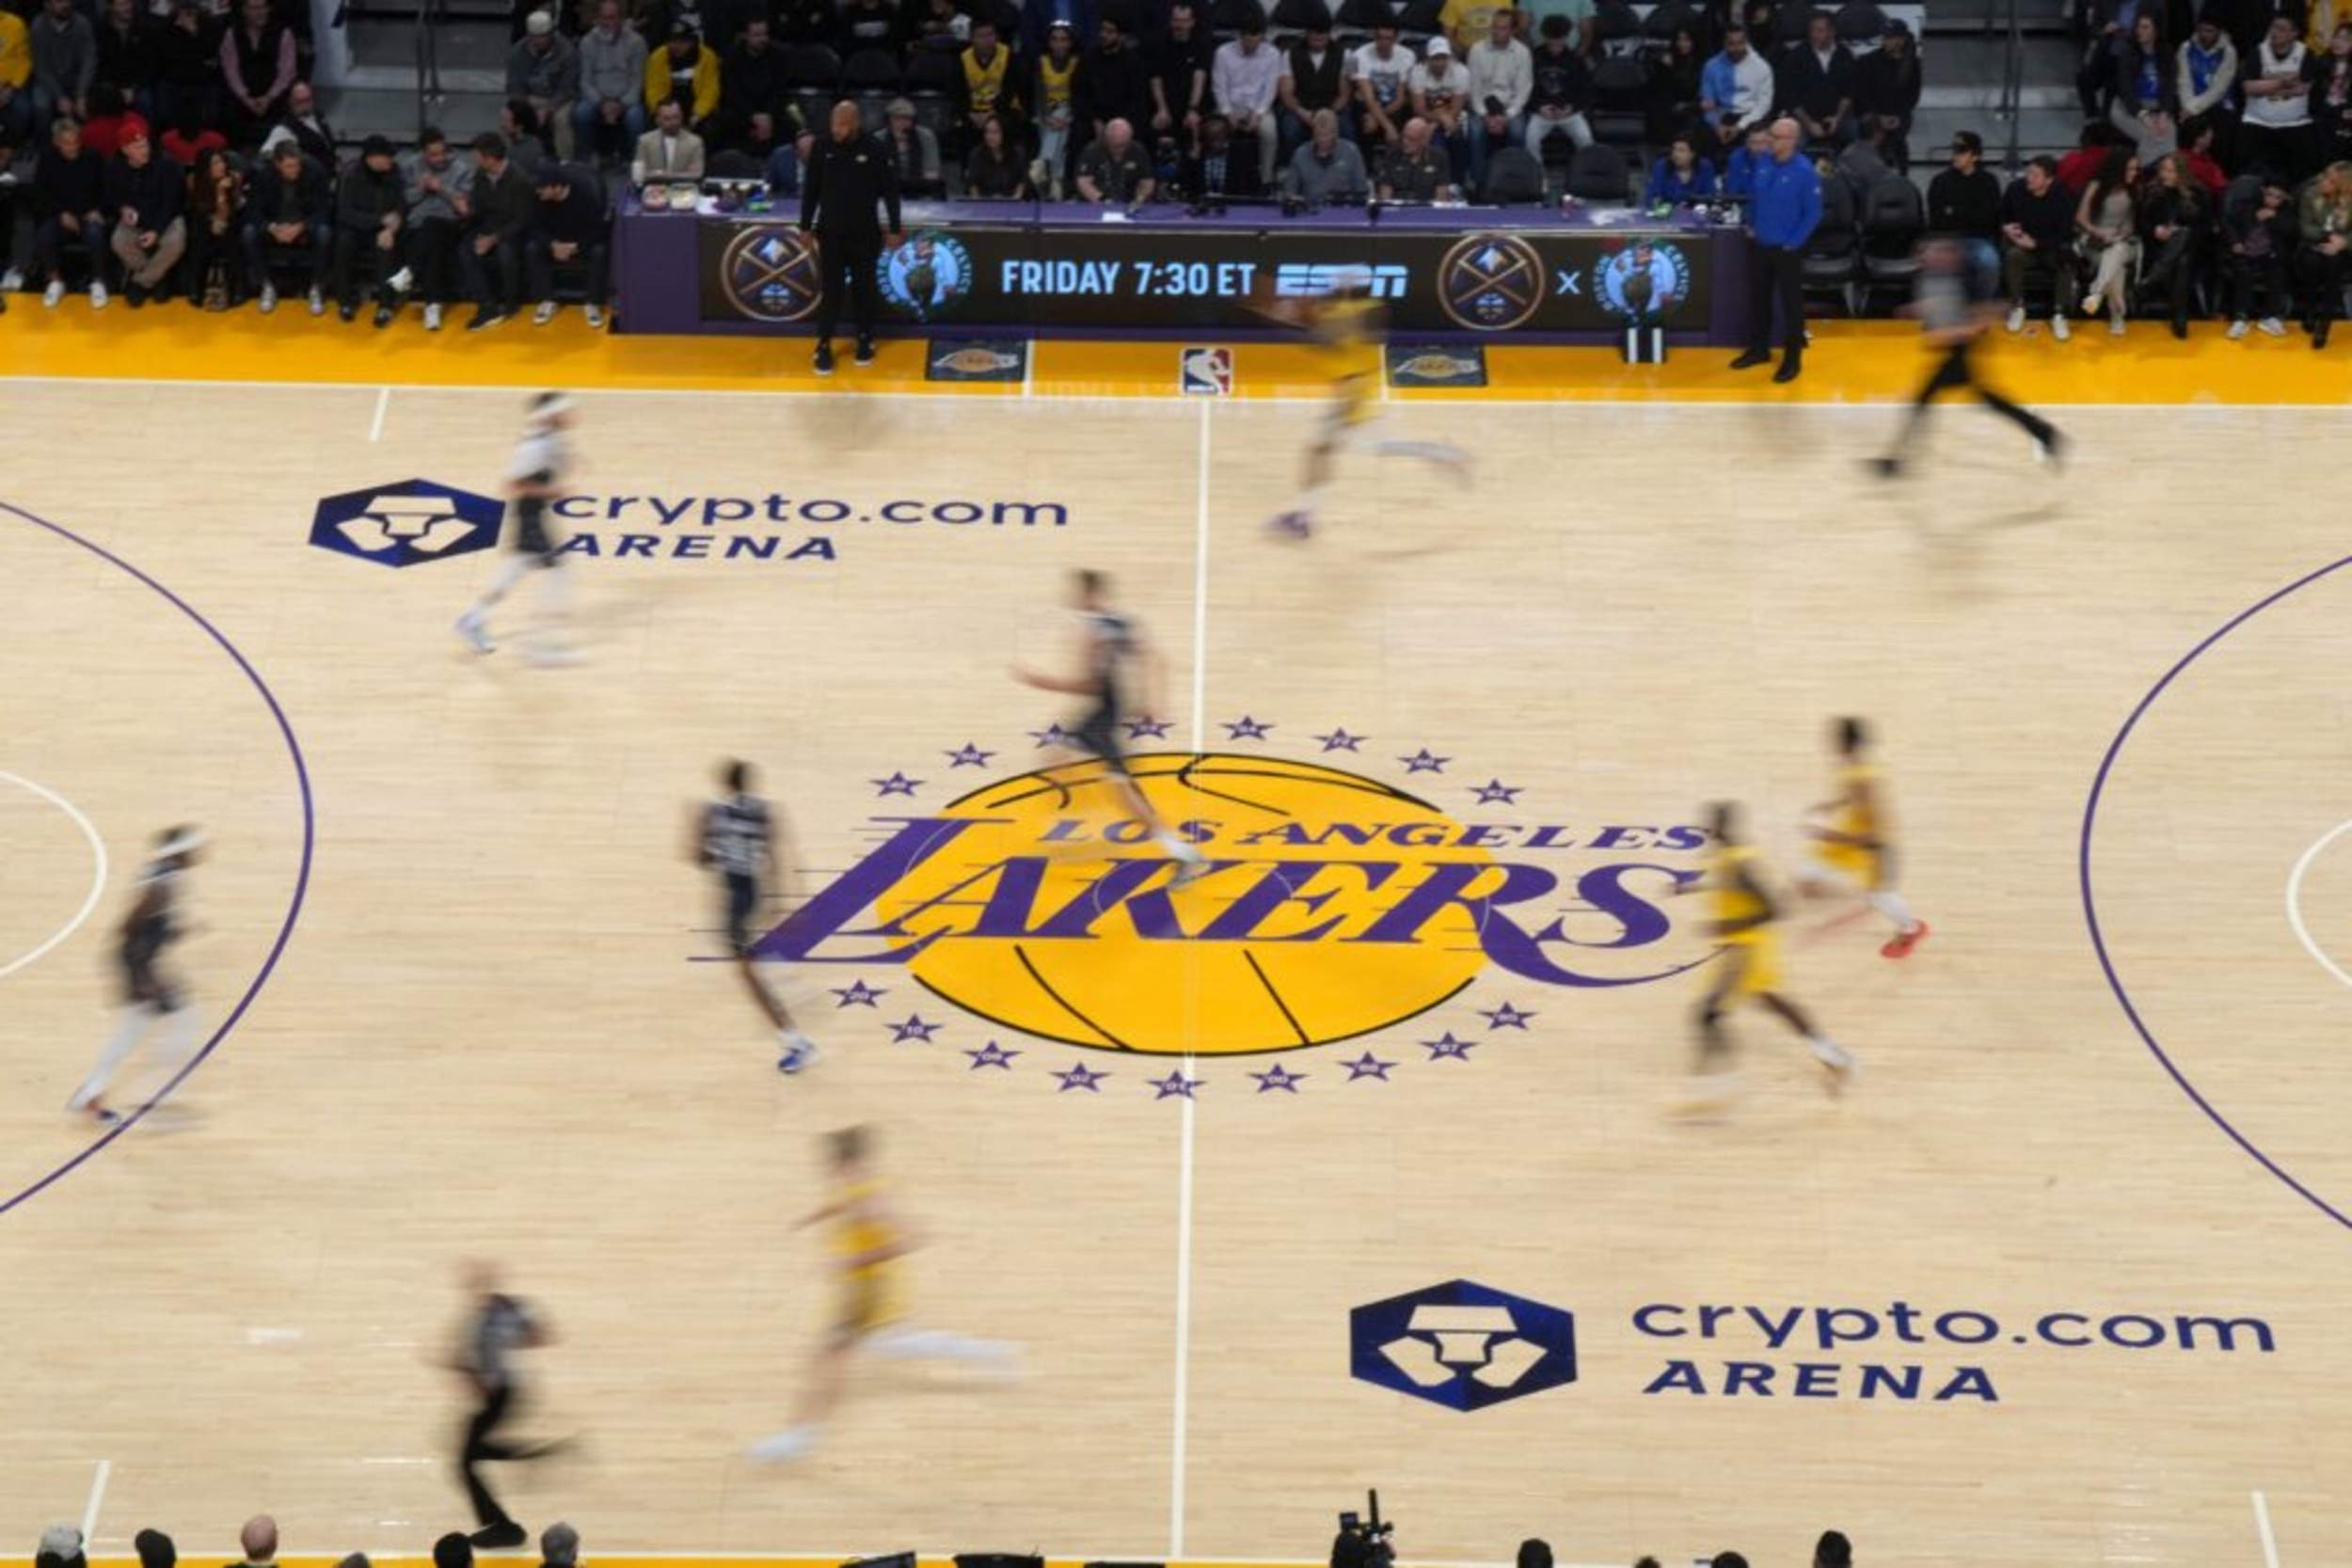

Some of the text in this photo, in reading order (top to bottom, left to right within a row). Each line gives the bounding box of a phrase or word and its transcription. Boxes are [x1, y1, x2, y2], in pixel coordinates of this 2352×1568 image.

[1001, 259, 1257, 295] FRIDAY 7:30 ET
[1276, 262, 1408, 297] ESPN
[551, 494, 1069, 527] crypto.com
[562, 532, 837, 561] ARENA
[1037, 818, 1710, 851] LOS ANGELES
[688, 816, 1731, 989] LAKERS
[1632, 1301, 2276, 1353] crypto.com
[1643, 1359, 2000, 1402] ARENA
